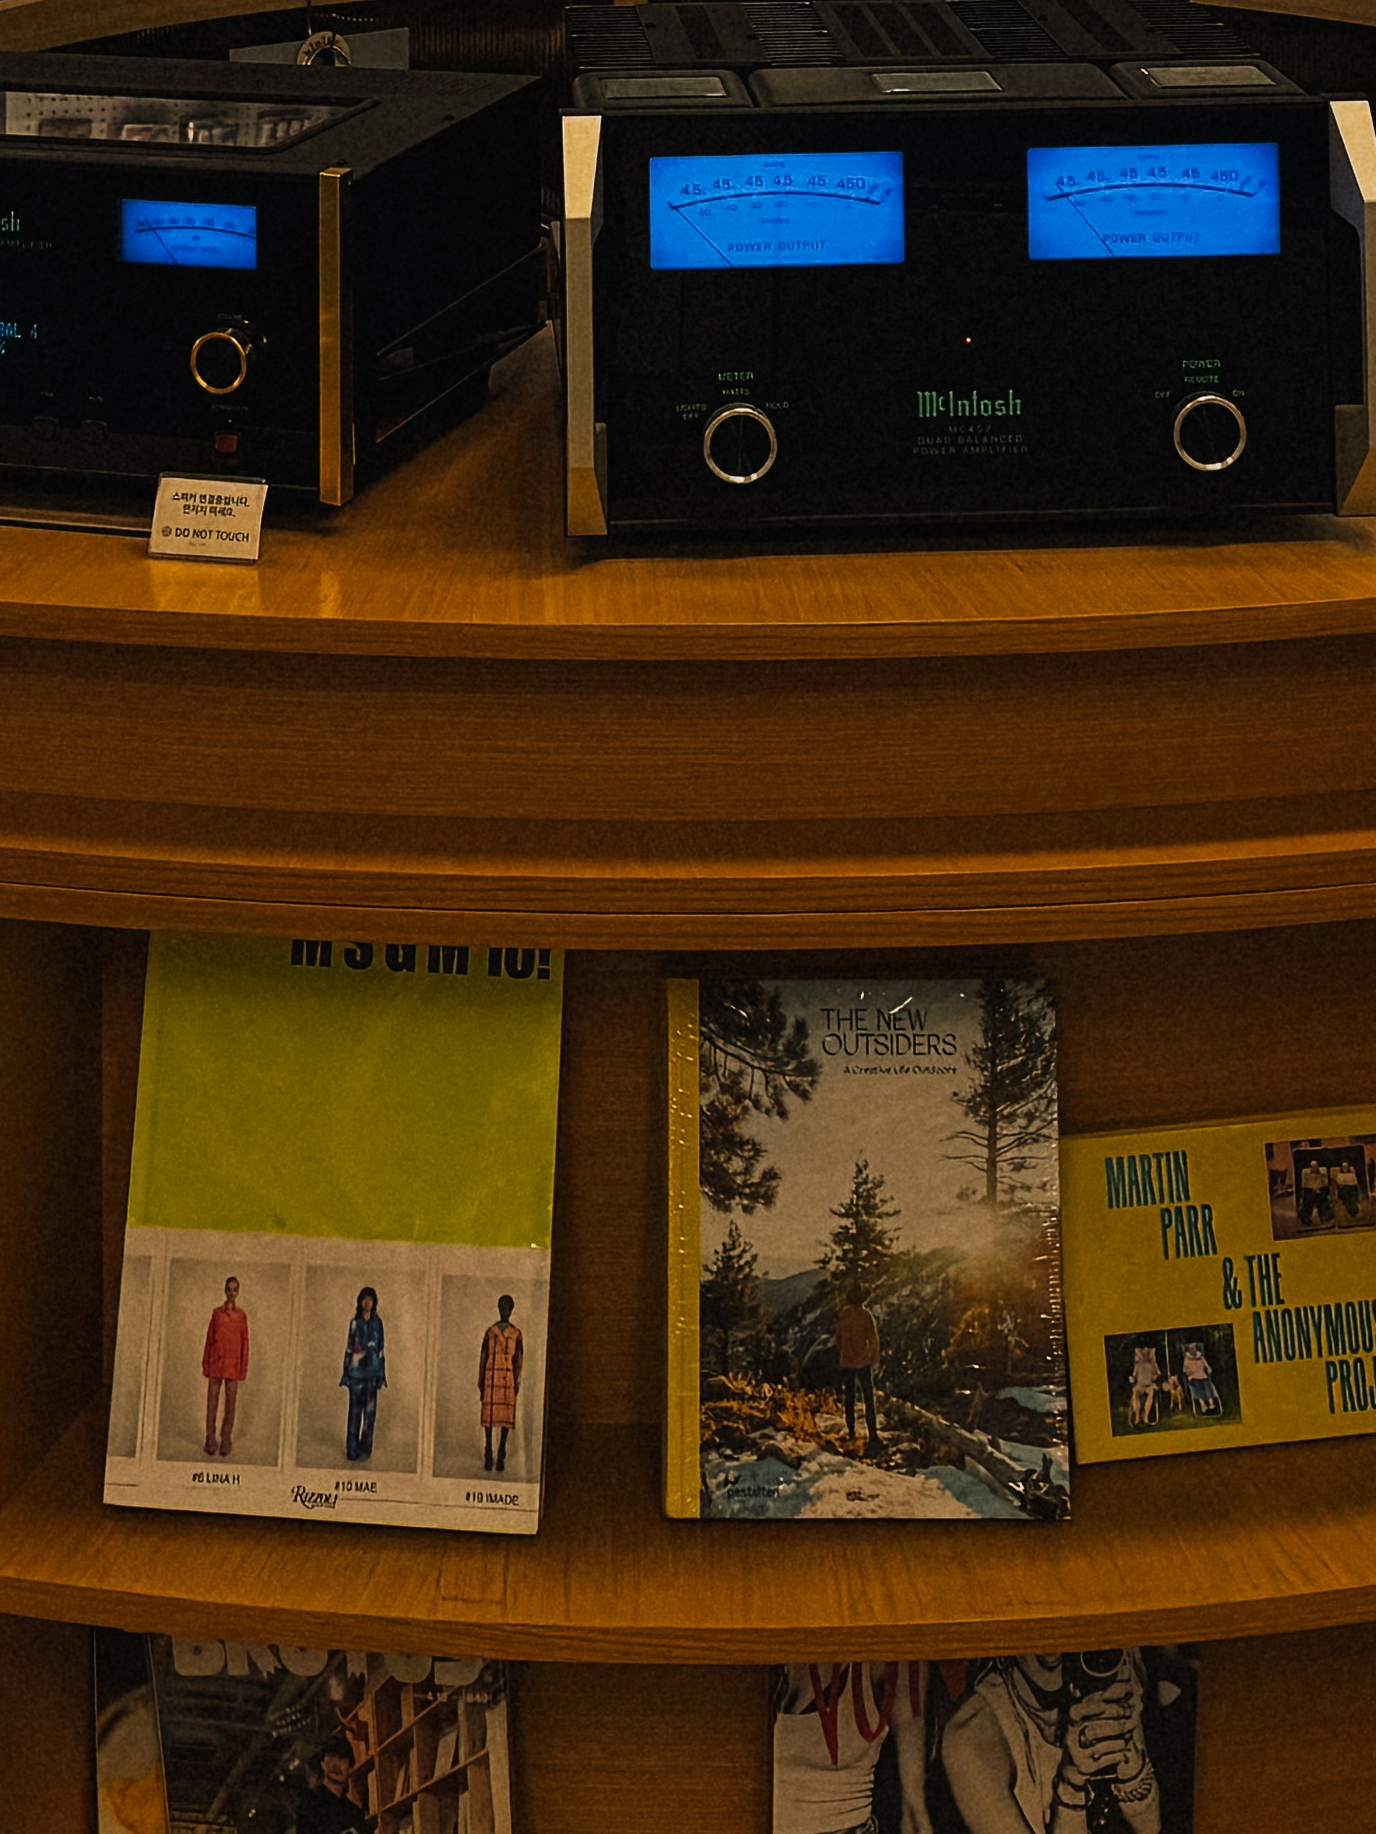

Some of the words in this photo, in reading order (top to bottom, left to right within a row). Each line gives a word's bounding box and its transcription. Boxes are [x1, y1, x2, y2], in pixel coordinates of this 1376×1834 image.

[1211, 169, 1239, 182] 450
[836, 178, 866, 190] 450
[1103, 231, 1146, 243] POWER
[1153, 231, 1202, 243] OUTPUT
[727, 241, 771, 252] POWER
[778, 240, 827, 251] OUTPUT
[29, 322, 39, 341] 4
[1154, 390, 1171, 399] OFF
[1231, 389, 1246, 398] ON
[916, 389, 1023, 418] McIntosh
[957, 435, 1023, 445] BALANCED
[912, 446, 956, 455] POWER
[962, 444, 1028, 454] AMPLIFIER
[175, 527, 190, 538] DO
[192, 528, 213, 540] NOT
[216, 530, 249, 542] TOUCH
[820, 1007, 868, 1031] THE
[876, 1007, 928, 1031] NEW
[821, 1032, 958, 1056] OUTSIDERS
[1104, 1149, 1190, 1210] MARTIN
[1160, 1203, 1218, 1261] PARR
[1222, 1256, 1243, 1311] &
[1243, 1252, 1285, 1307] THE
